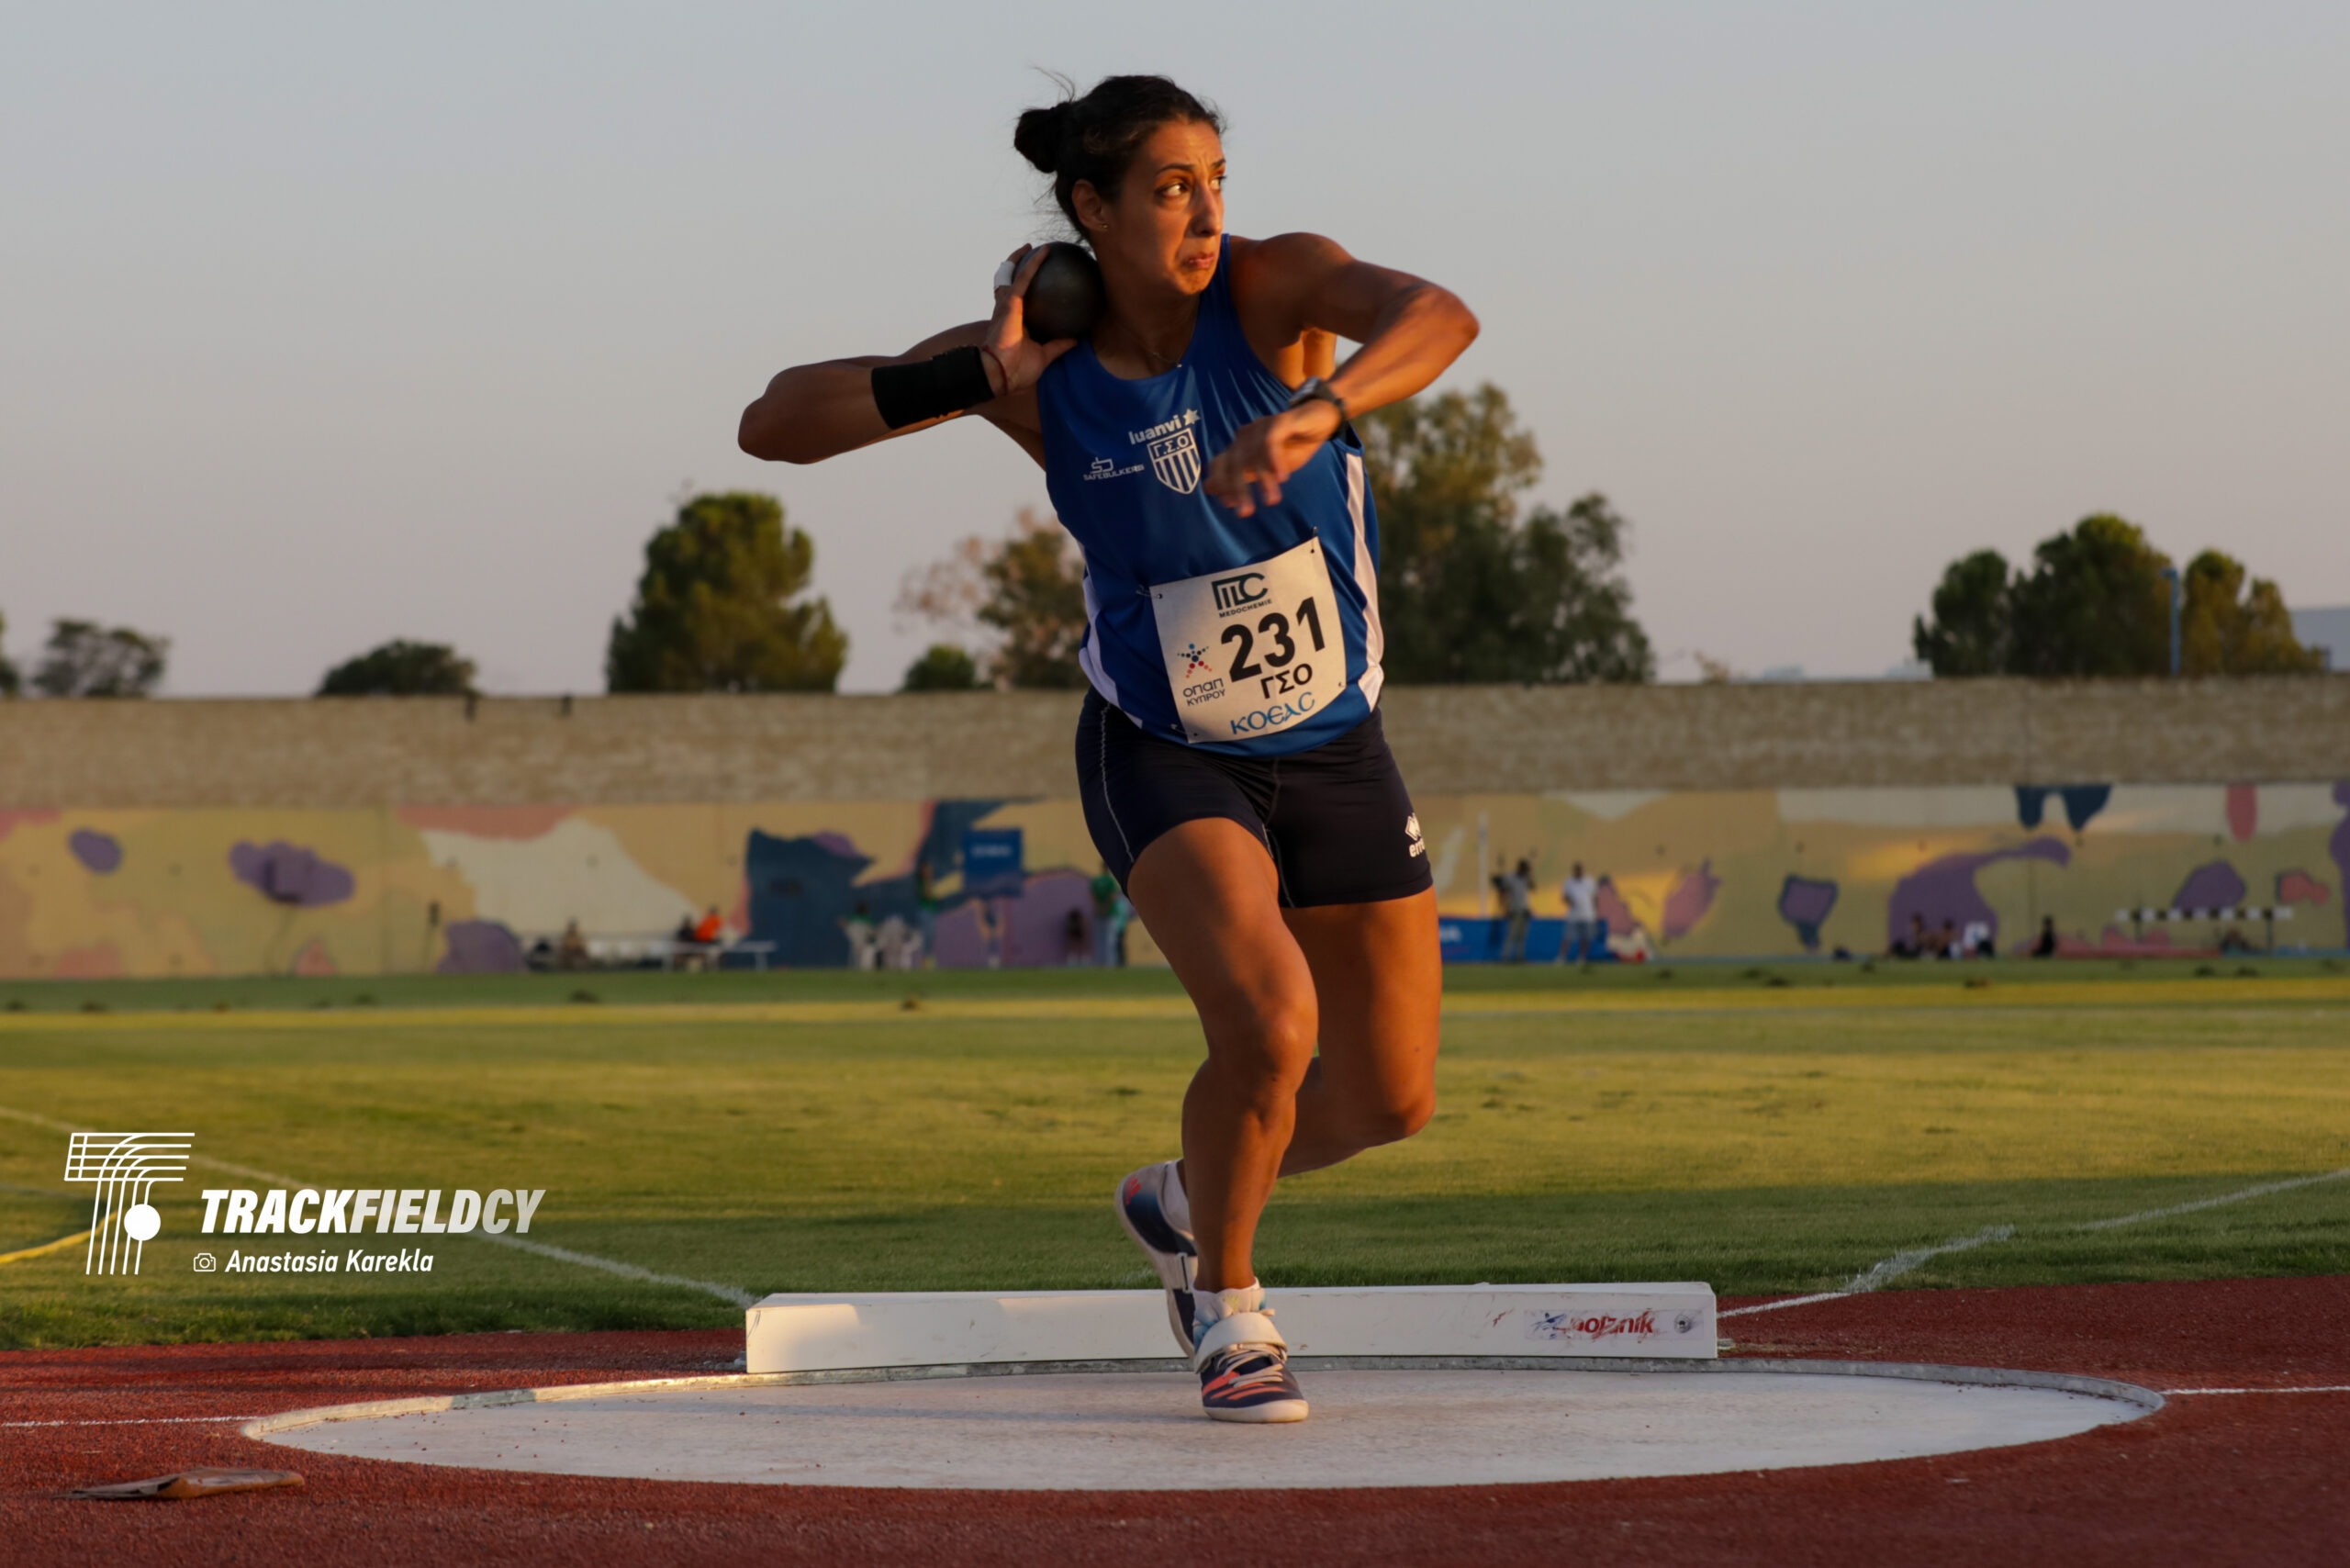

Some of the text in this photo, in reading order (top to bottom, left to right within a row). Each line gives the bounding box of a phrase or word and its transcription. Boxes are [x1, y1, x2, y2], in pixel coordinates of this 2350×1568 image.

[1128, 414, 1182, 445] luanvi
[1219, 599, 1272, 619] MEDOCHEMIE
[1221, 596, 1326, 683] 231
